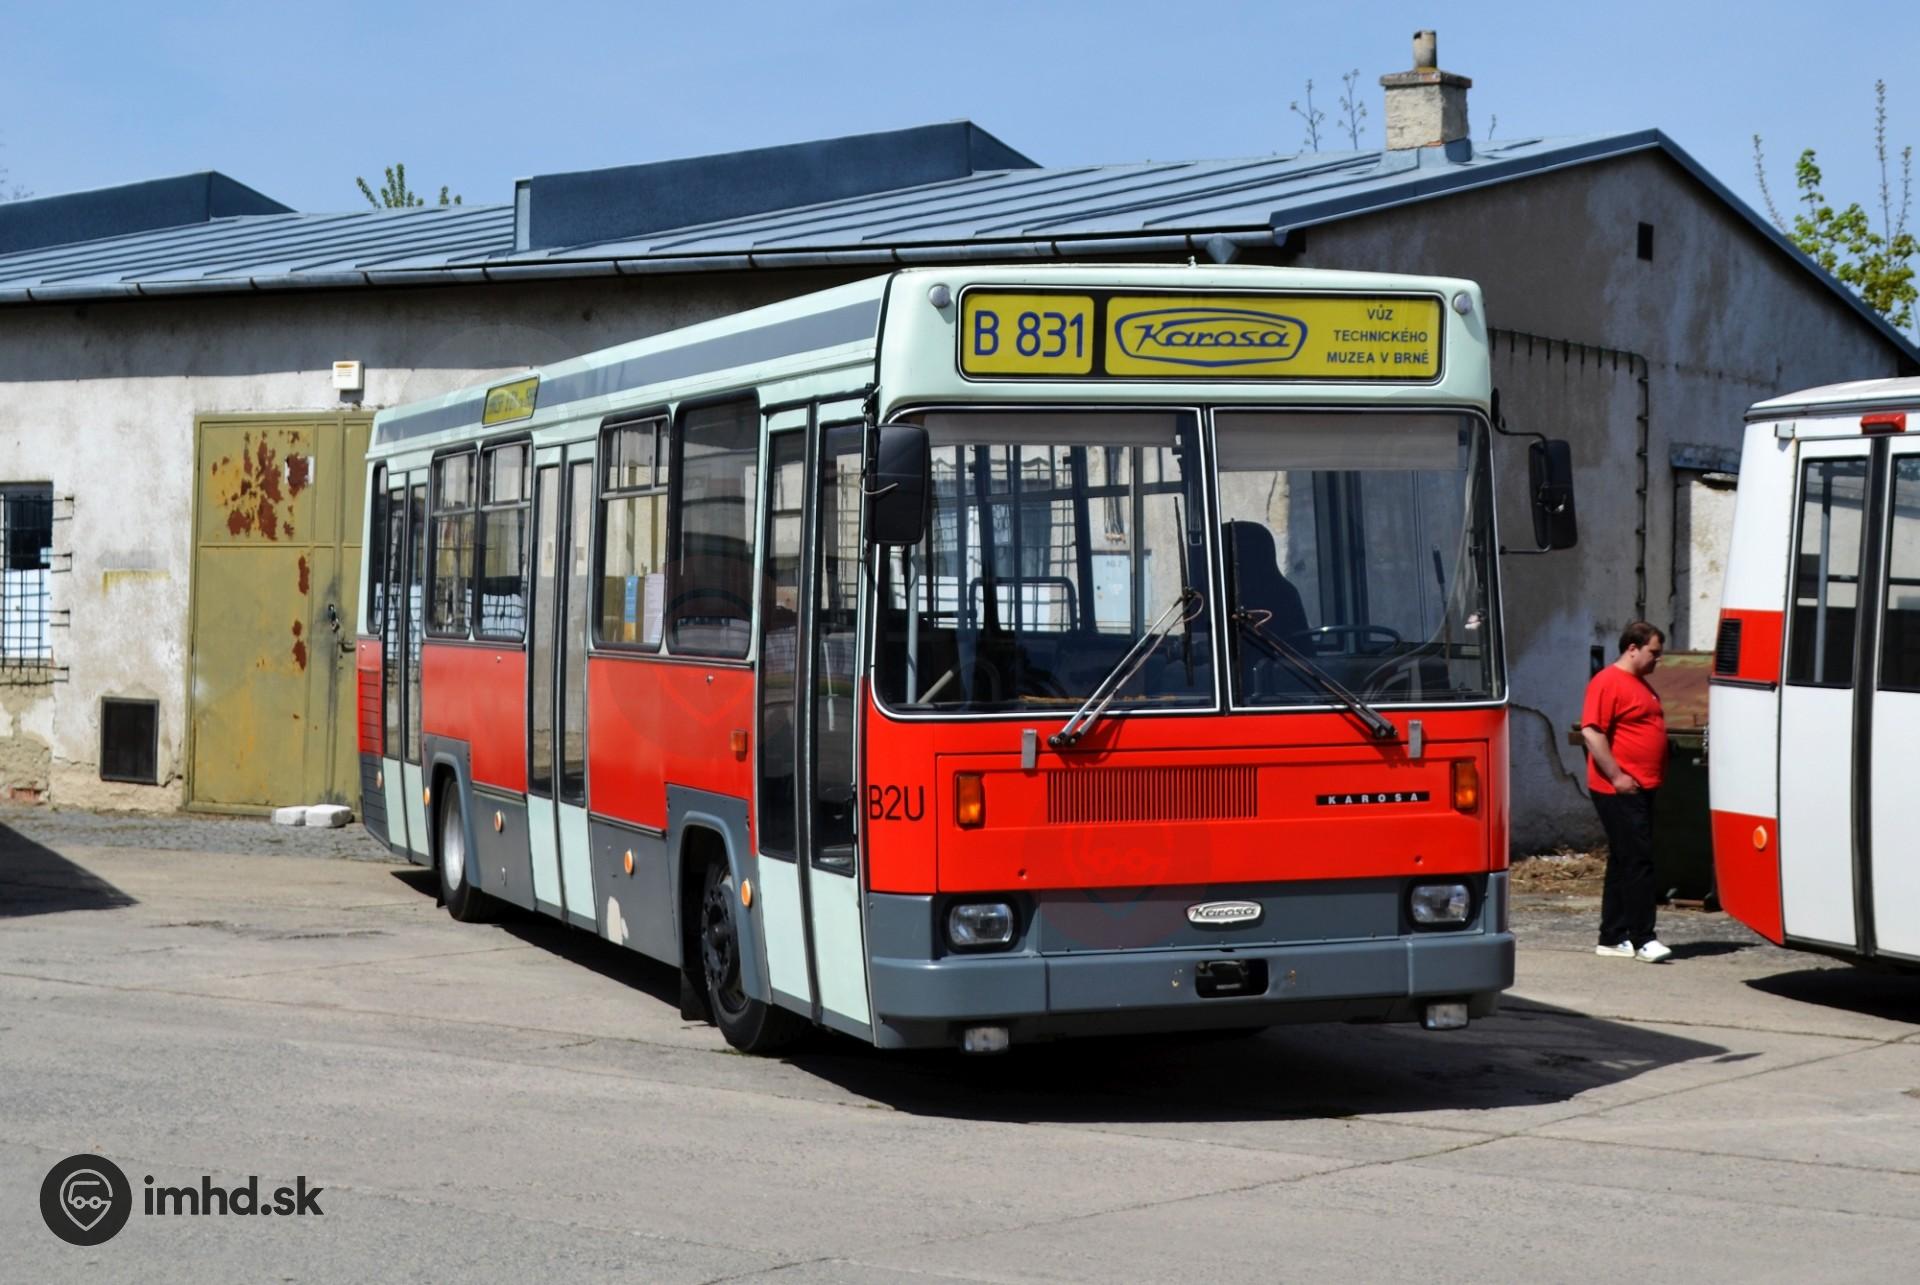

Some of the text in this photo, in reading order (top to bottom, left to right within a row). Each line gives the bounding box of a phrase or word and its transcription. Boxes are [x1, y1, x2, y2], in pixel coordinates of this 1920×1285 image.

[1367, 303, 1393, 320] VŮZ
[974, 310, 1084, 358] B 831
[1134, 317, 1290, 352] Karosa
[1333, 328, 1428, 343] TECHNICKÉHO
[1326, 351, 1375, 363] MUZEA
[1380, 352, 1389, 363] V
[869, 784, 925, 821] B2U
[1328, 793, 1418, 805] KAROSA
[1192, 906, 1256, 919] Karosa
